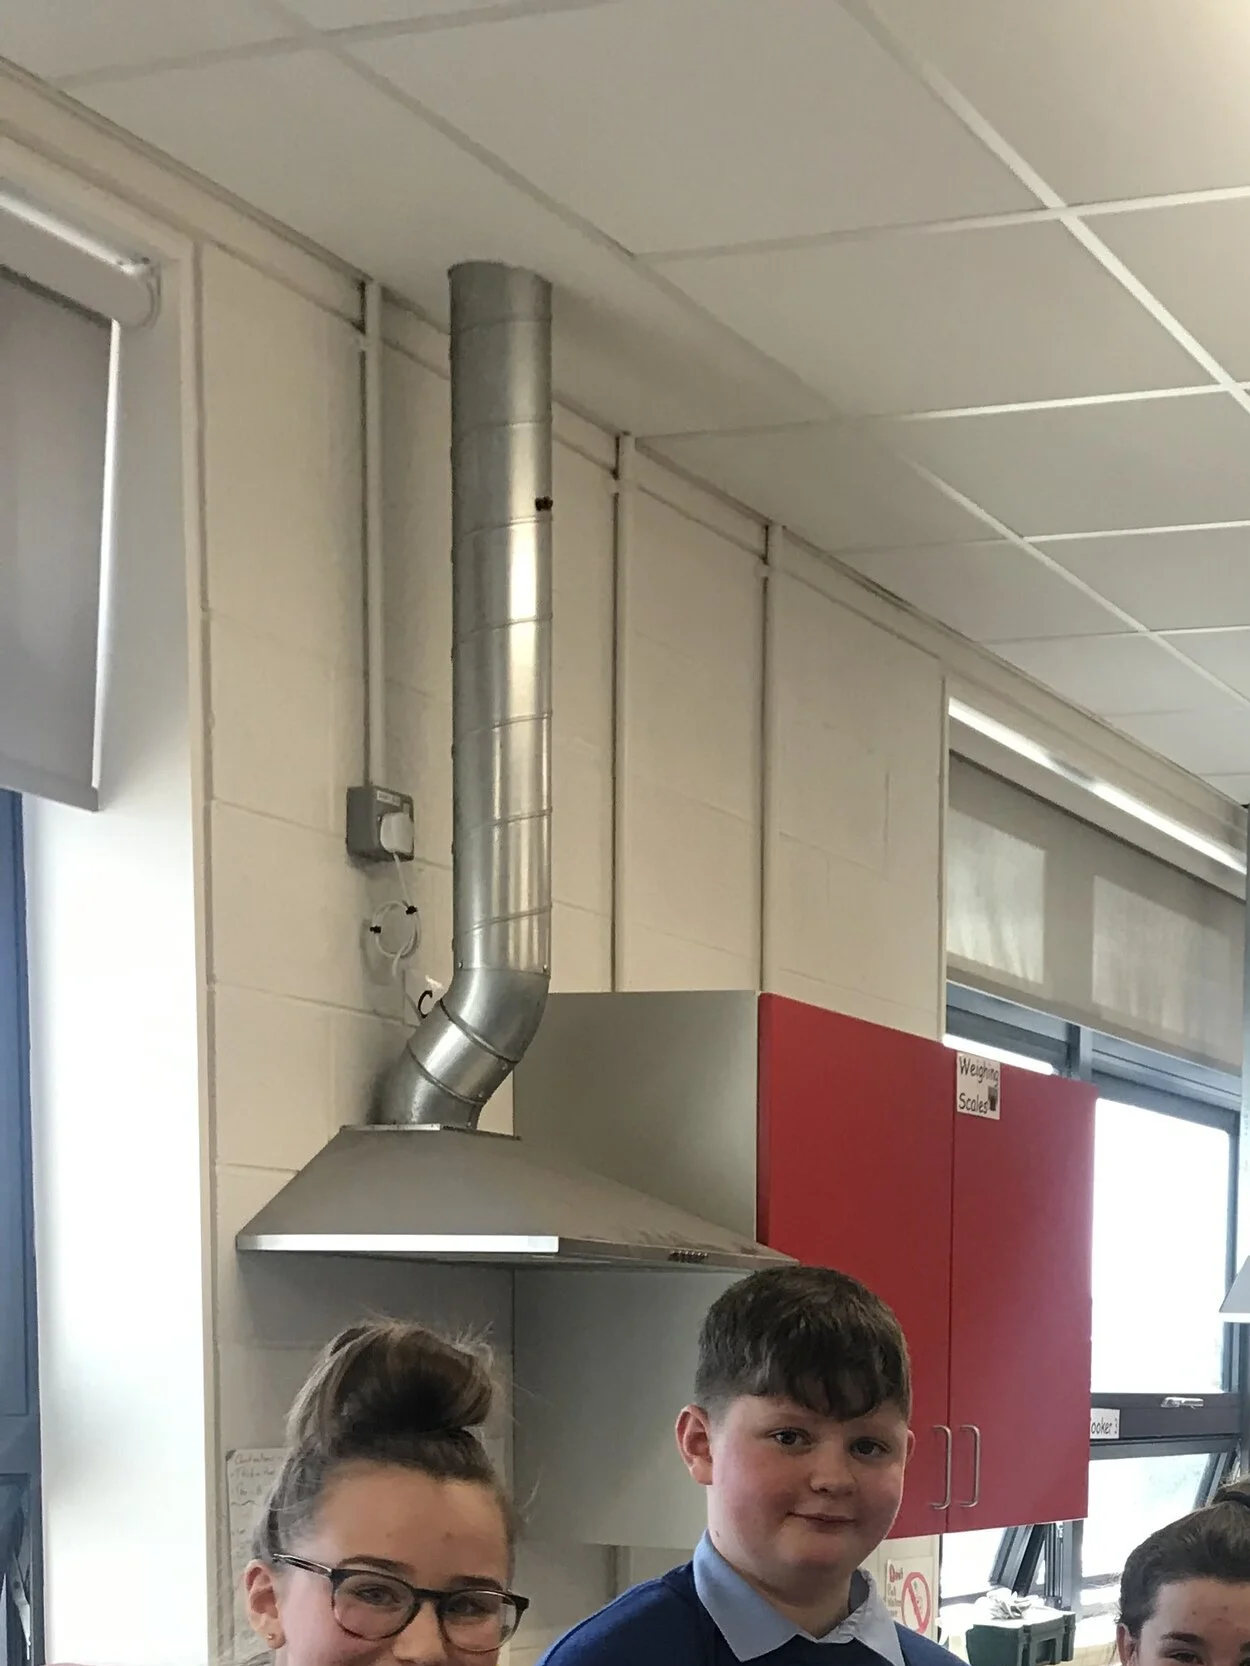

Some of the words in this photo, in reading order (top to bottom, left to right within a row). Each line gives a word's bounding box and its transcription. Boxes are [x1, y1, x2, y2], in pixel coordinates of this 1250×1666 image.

[959, 1054, 999, 1088] Weighing
[959, 1092, 989, 1114] Scales
[1091, 1417, 1112, 1434] ooker
